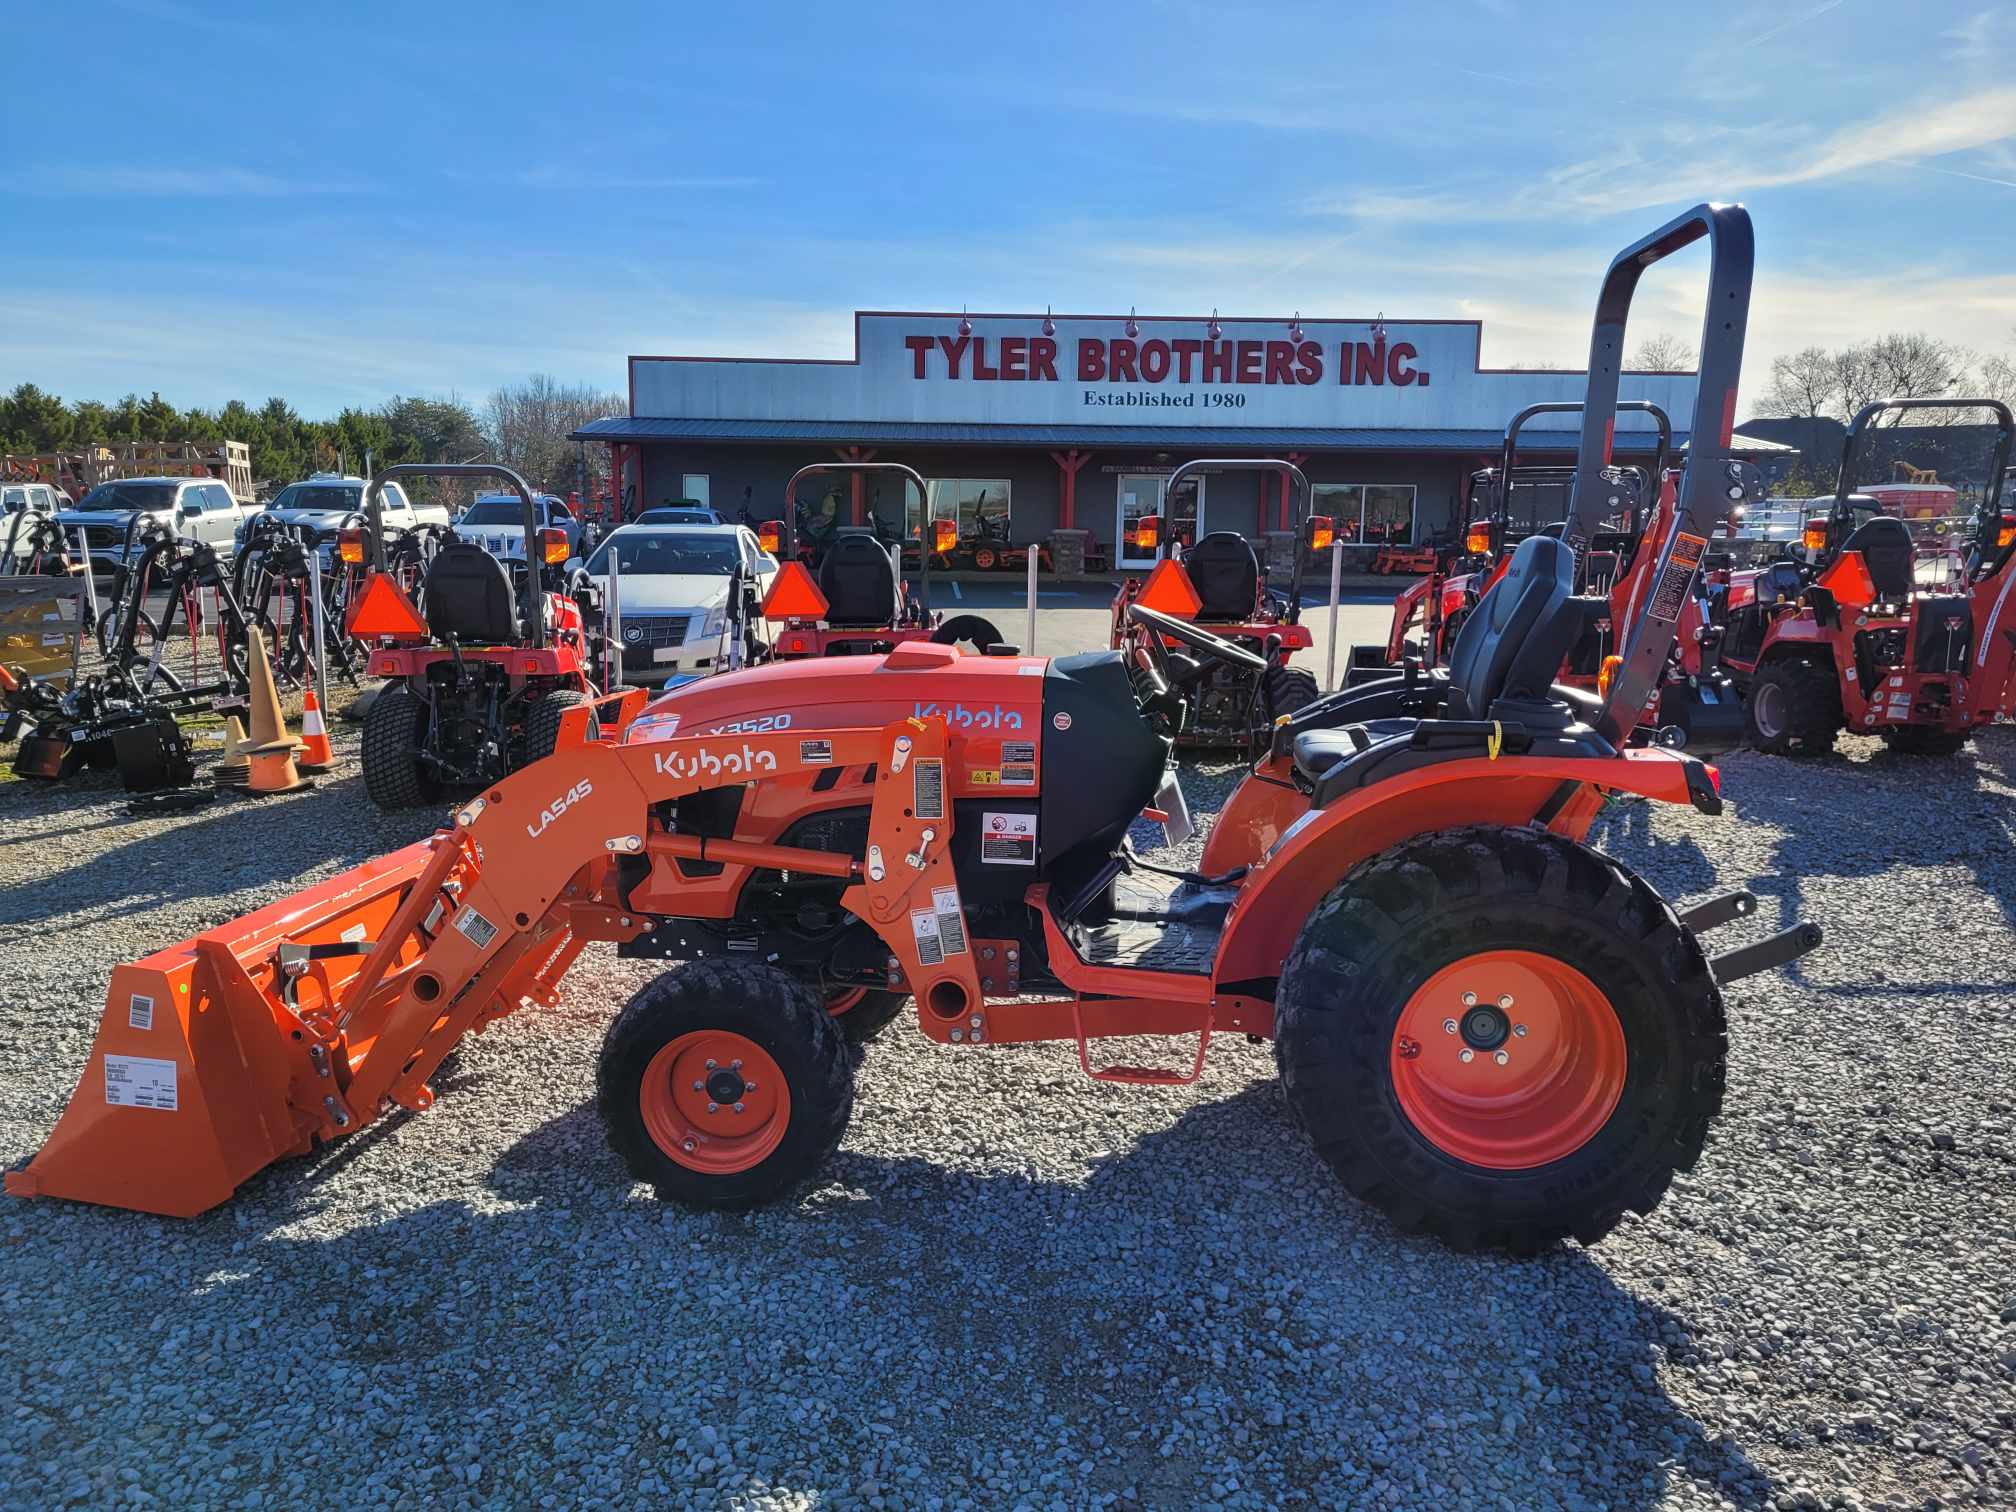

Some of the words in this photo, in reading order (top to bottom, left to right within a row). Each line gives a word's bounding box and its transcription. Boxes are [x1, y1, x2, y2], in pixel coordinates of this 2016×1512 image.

[905, 335, 1059, 381] TYLER
[1077, 337, 1324, 385] BROTHERS
[1339, 341, 1430, 387] INC.
[1083, 390, 1195, 407] Established
[1202, 391, 1247, 408] 1980
[654, 744, 777, 779] Kubota
[526, 777, 593, 838] LA545
